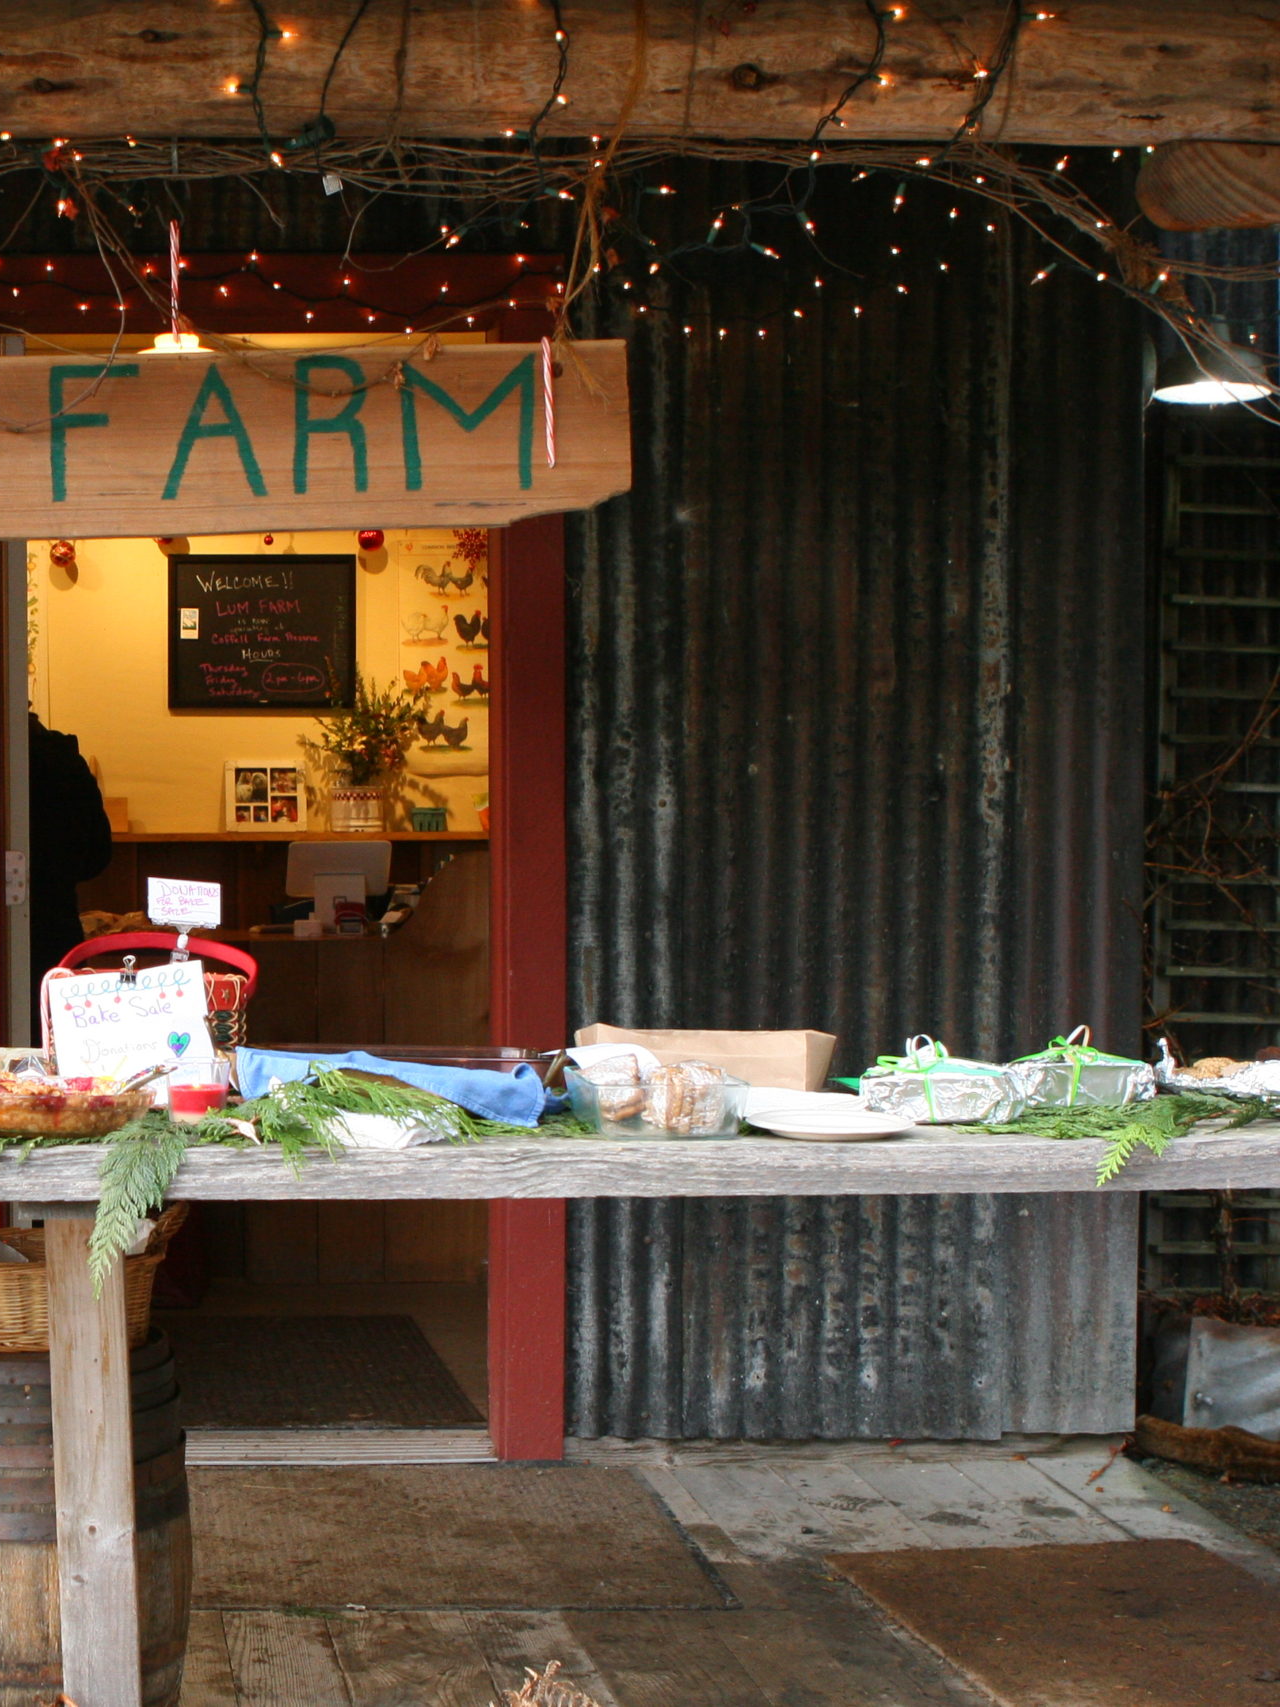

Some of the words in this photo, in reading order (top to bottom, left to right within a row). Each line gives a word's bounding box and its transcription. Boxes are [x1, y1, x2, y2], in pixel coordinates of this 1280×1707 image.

[48, 354, 536, 503] FARM
[216, 601, 249, 616] LUM
[259, 600, 301, 614] FARM
[205, 675, 240, 689] Friday
[73, 1005, 120, 1028] Bake
[129, 996, 173, 1018] Sale
[80, 1038, 158, 1064] Donations
